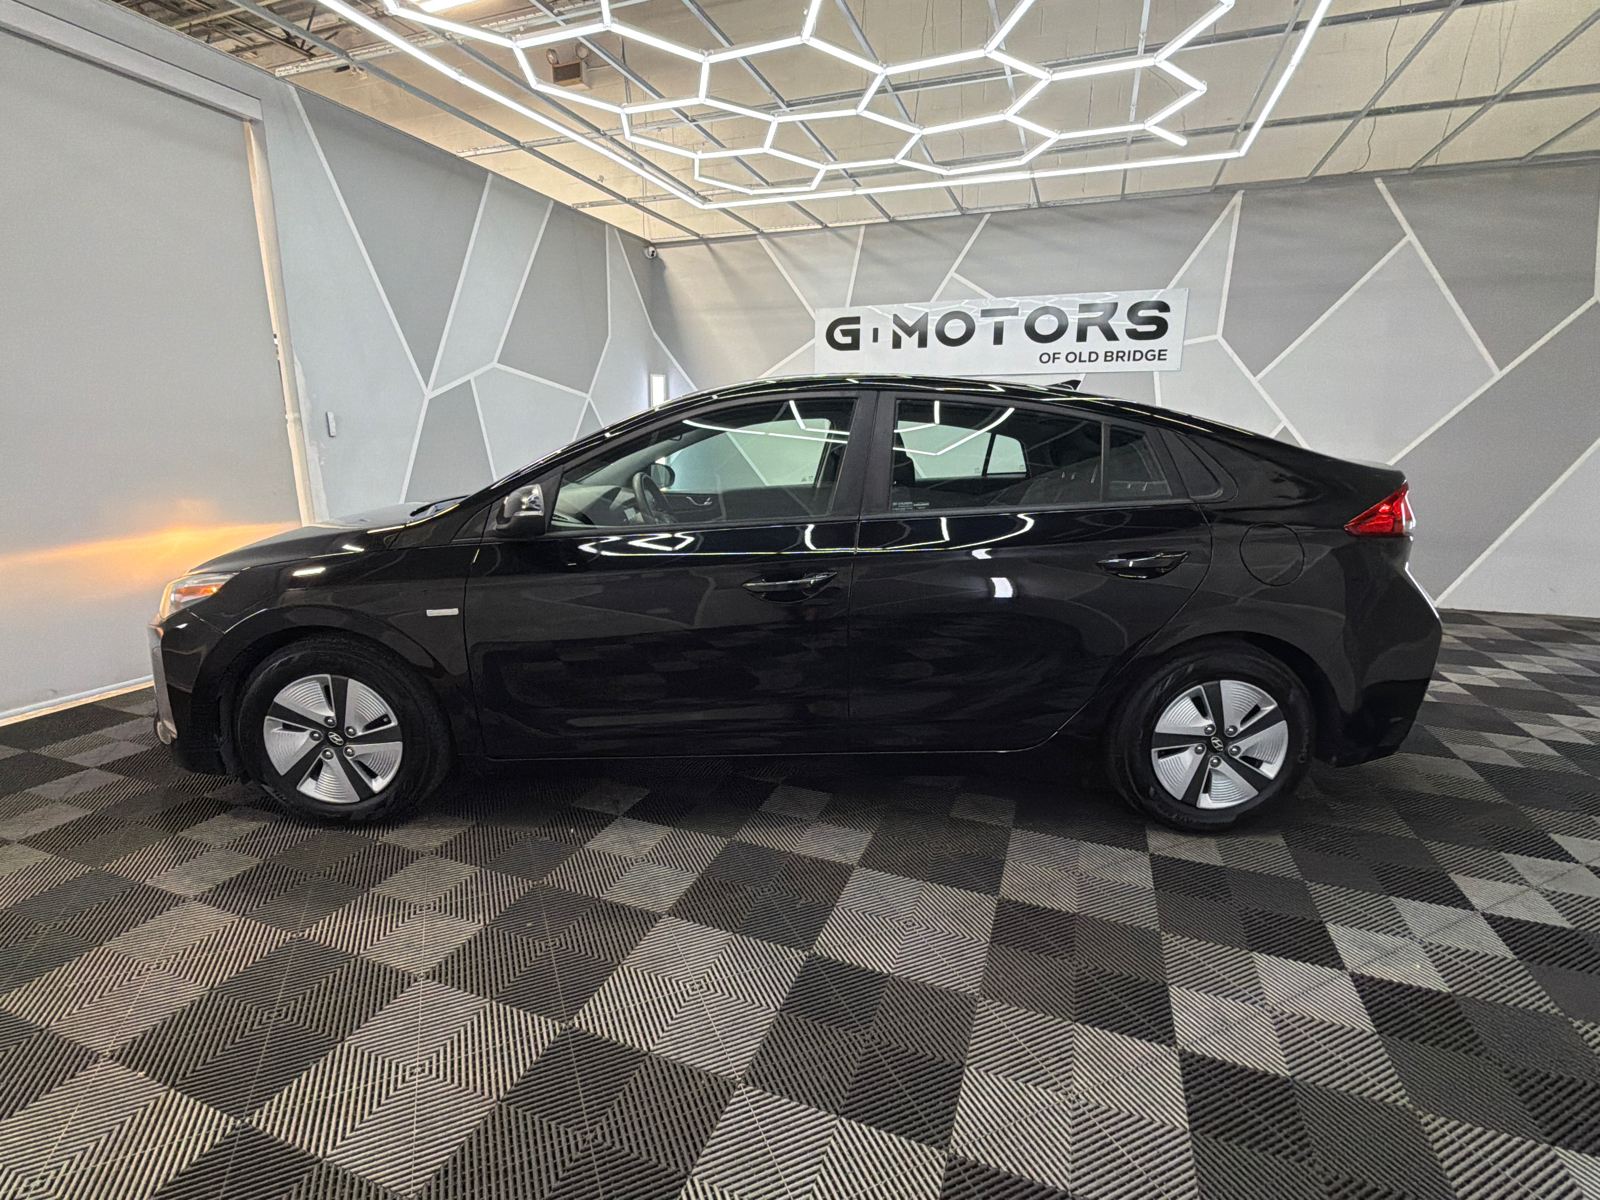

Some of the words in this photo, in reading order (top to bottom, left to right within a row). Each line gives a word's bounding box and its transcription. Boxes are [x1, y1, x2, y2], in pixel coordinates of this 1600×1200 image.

[1039, 352, 1061, 364] OF
[1065, 351, 1099, 363] OLD
[1104, 349, 1168, 362] BRIDGE
